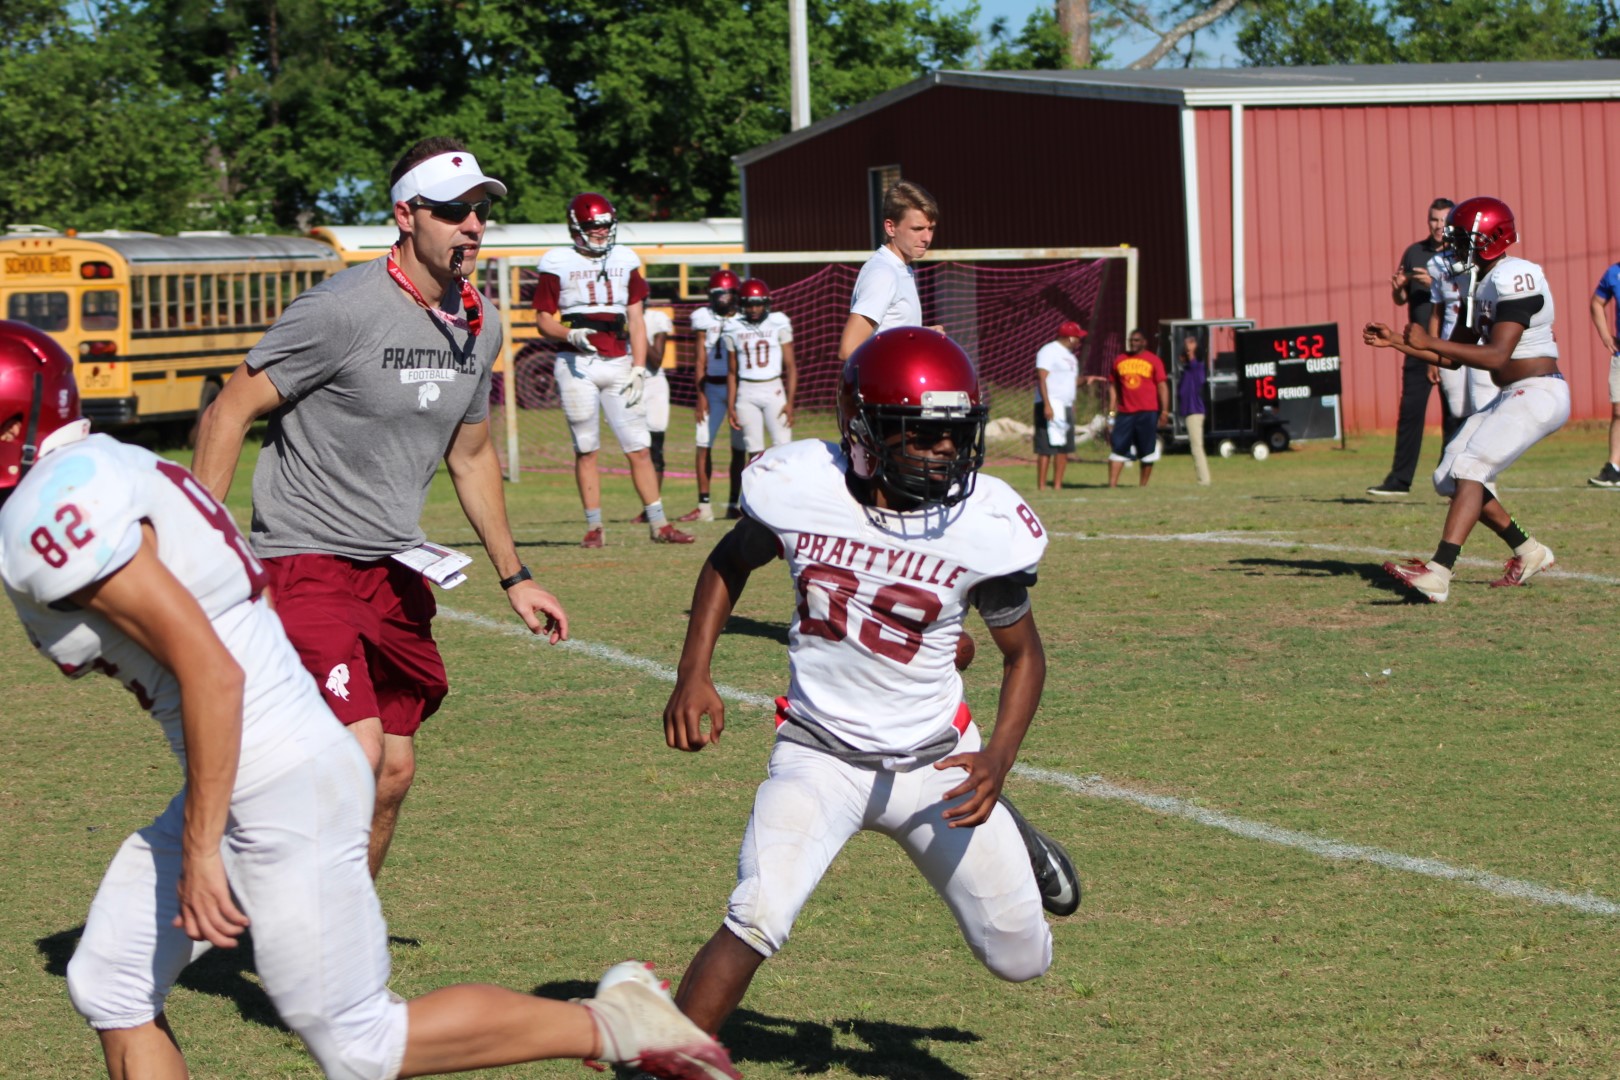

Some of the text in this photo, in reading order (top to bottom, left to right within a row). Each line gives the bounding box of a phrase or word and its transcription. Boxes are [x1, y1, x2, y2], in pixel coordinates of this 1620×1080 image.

[5, 255, 71, 274] SCHOOL BUS
[569, 267, 624, 281] PRATTILLE
[586, 279, 613, 307] 11
[1513, 273, 1536, 293] 20
[743, 339, 770, 369] 10
[1273, 335, 1324, 359] 4:52
[1244, 361, 1276, 378] HOME
[1306, 356, 1340, 373] GUEST
[408, 370, 450, 381] FOOTBALL
[1255, 376, 1276, 400] 16
[1277, 386, 1311, 399] PERIOD
[30, 504, 96, 569] 82
[793, 532, 968, 589] PRATTVILLE
